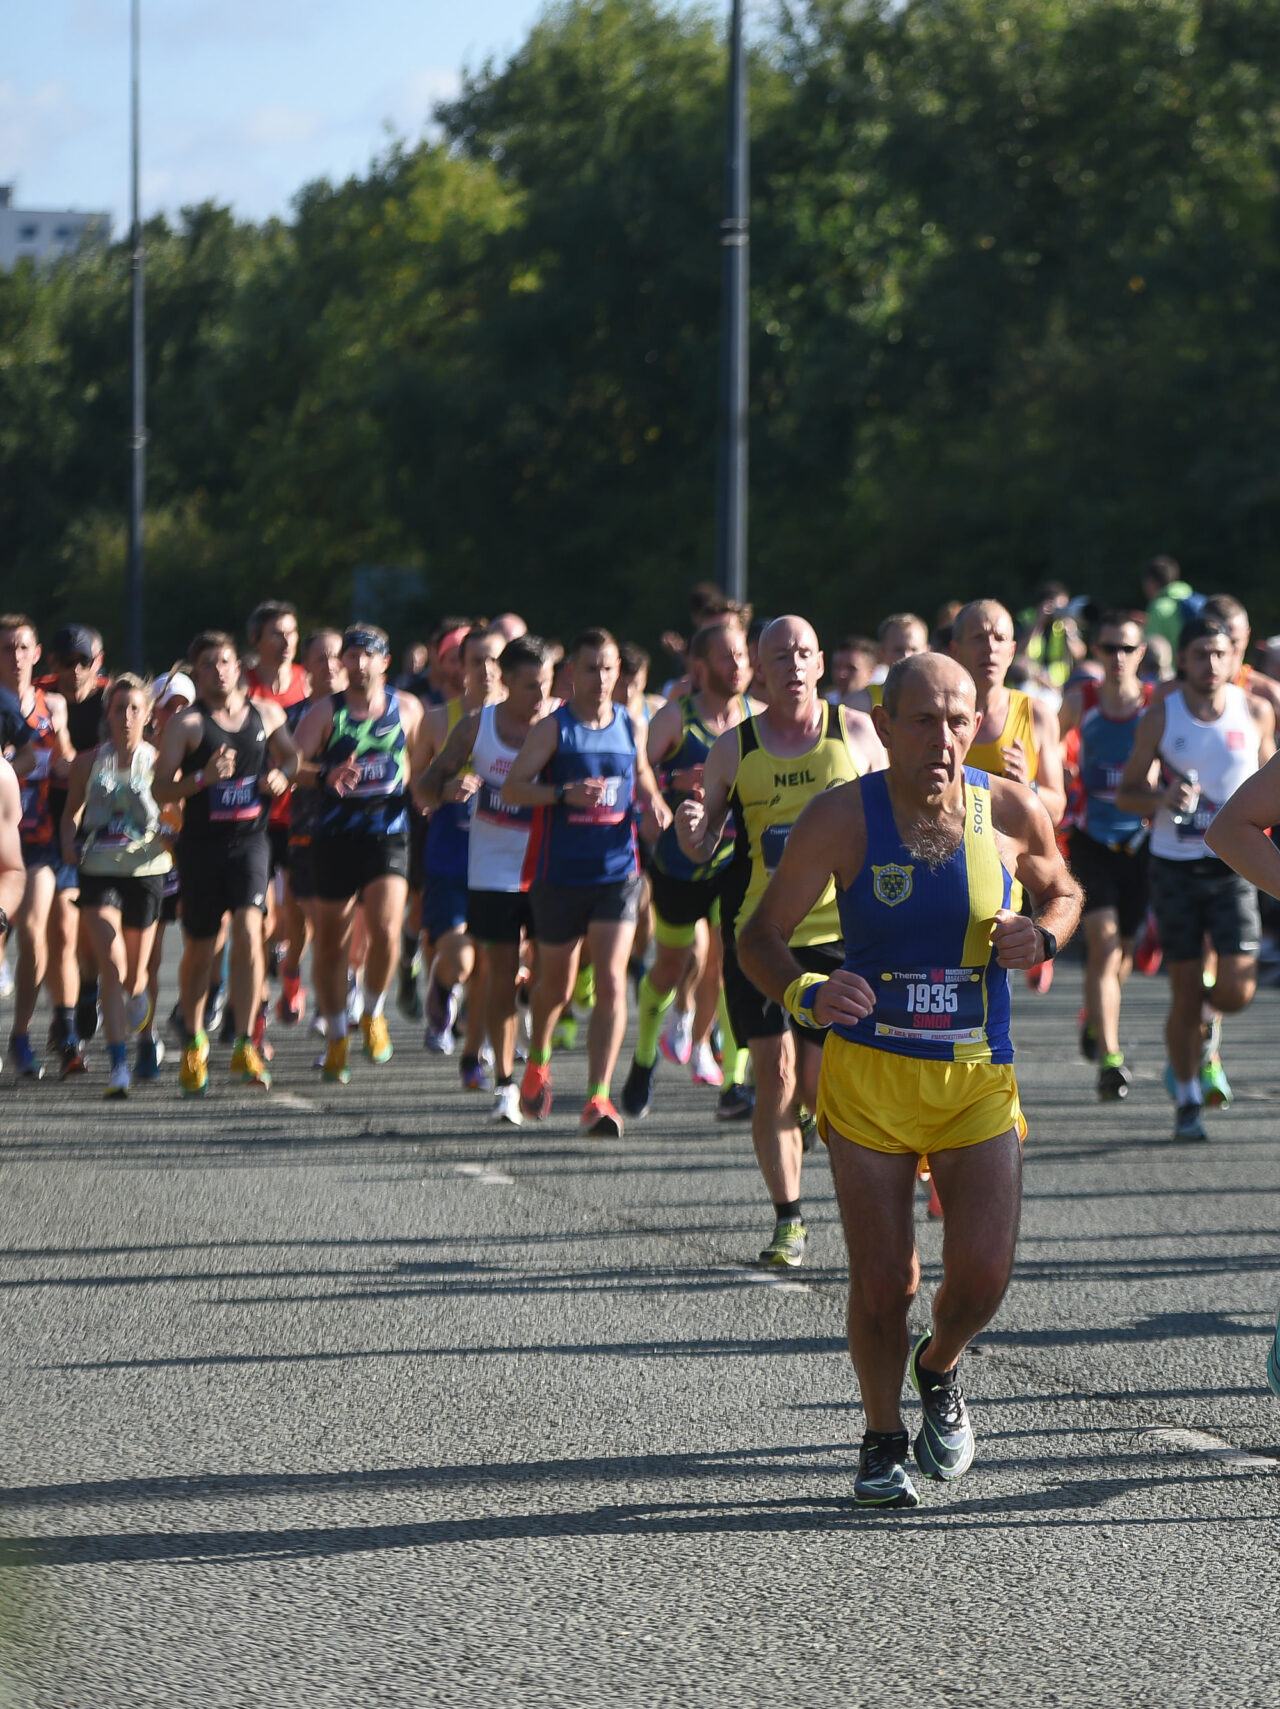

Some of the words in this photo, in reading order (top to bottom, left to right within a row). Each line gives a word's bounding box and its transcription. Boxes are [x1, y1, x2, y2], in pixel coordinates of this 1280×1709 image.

[774, 769, 816, 787] NEIL
[973, 794, 984, 835] soar
[892, 971, 927, 980] Therme
[907, 983, 958, 1013] 1935
[912, 1014, 951, 1029] SIMON
